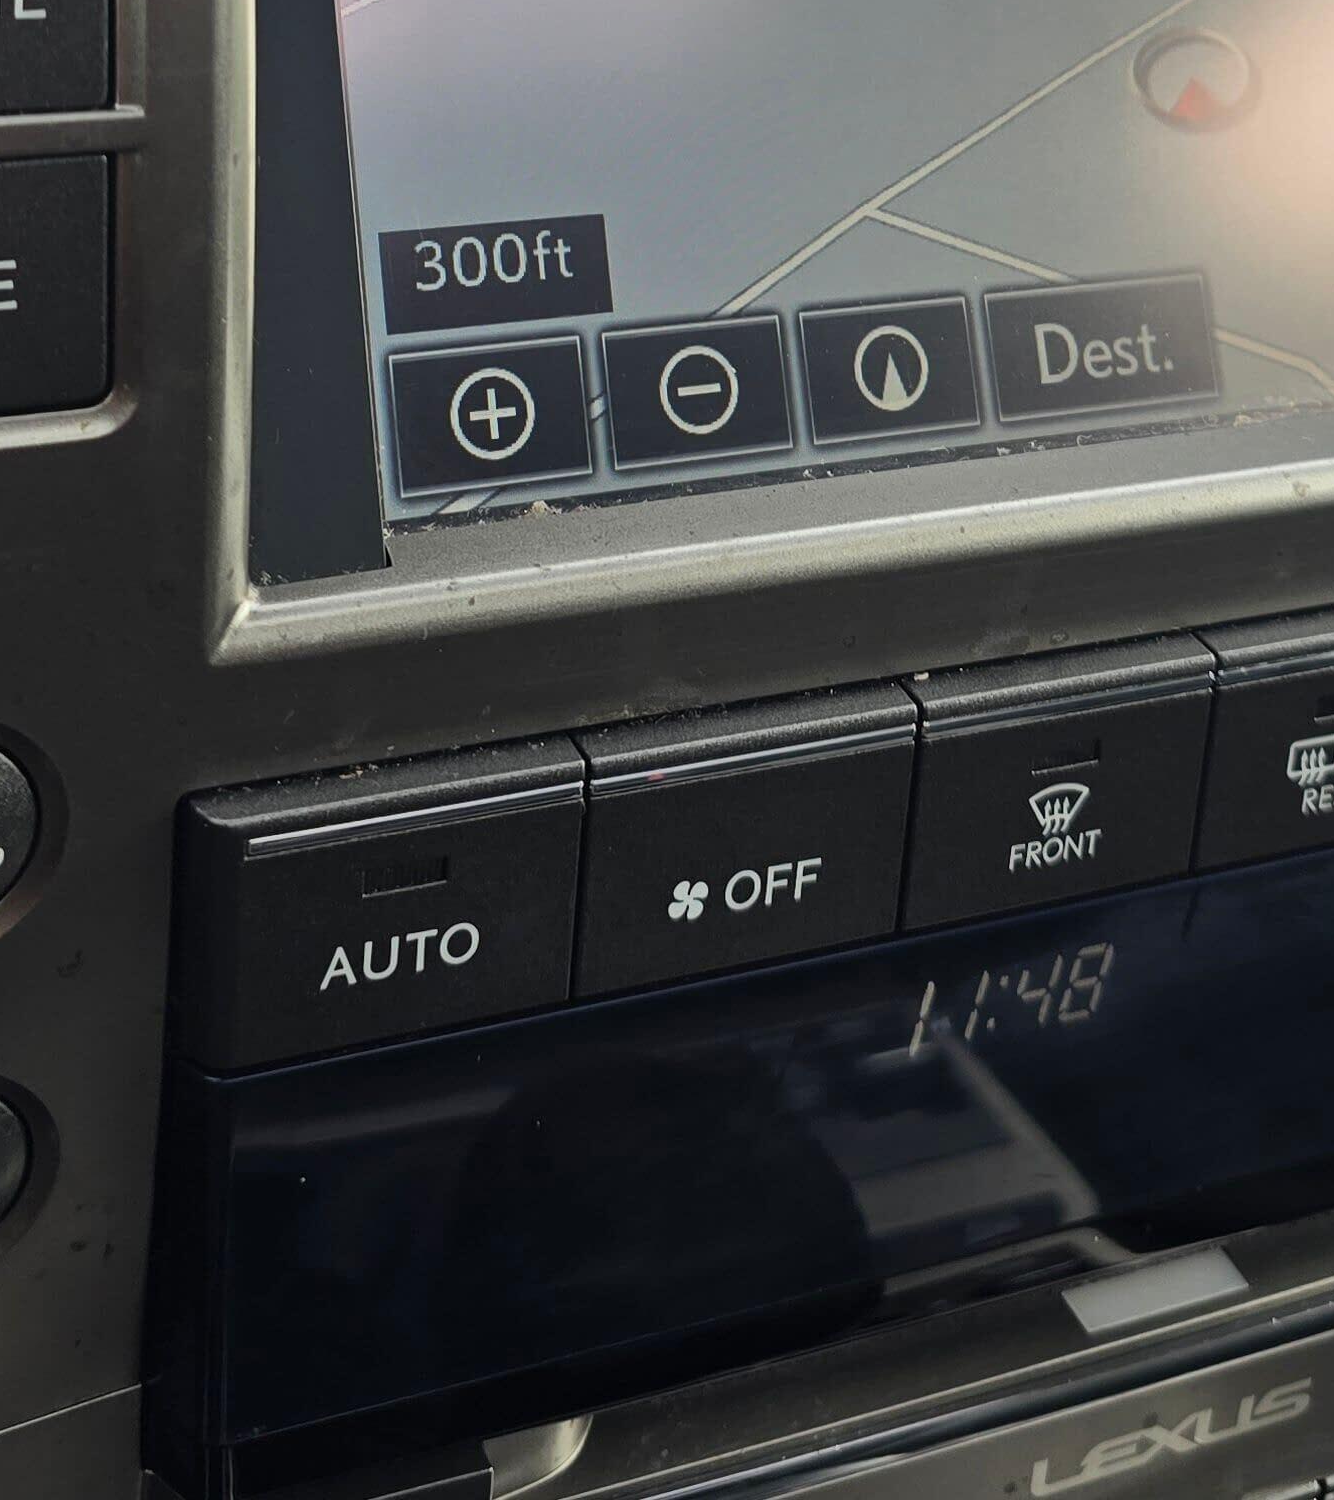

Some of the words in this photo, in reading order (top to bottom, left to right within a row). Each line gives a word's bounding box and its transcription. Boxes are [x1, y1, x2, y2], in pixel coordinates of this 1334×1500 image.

[414, 229, 575, 293] 300ft
[1033, 320, 1175, 387] Dest.
[1008, 828, 1103, 873] FRONT
[724, 857, 823, 912] OFF
[319, 922, 480, 993] AUTO
[908, 942, 1115, 1058] 11:48
[1031, 1377, 1312, 1496] LEXUS
